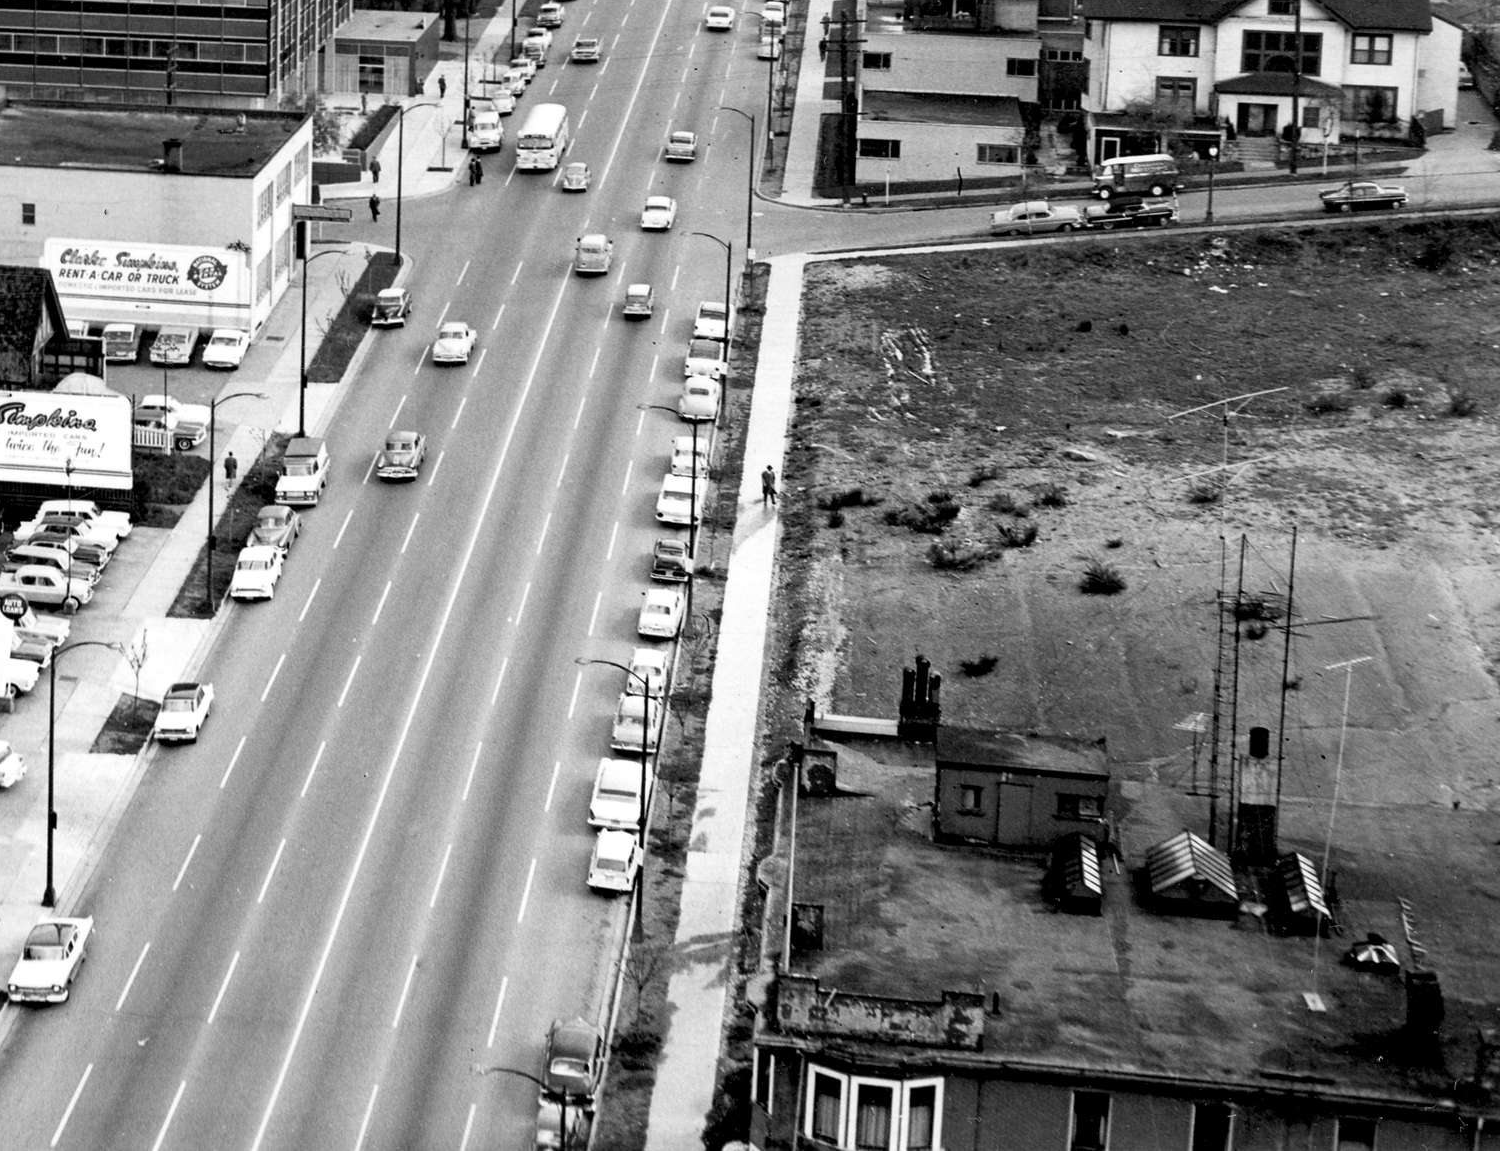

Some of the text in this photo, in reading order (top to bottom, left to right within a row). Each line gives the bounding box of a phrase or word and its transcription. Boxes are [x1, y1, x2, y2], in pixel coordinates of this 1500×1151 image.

[60, 248, 107, 267] Clarke
[128, 272, 142, 282] OR
[147, 273, 179, 285] TRUCK
[175, 288, 197, 296] LEASE
[42, 439, 60, 455] the
[4, 598, 22, 607] AUTO
